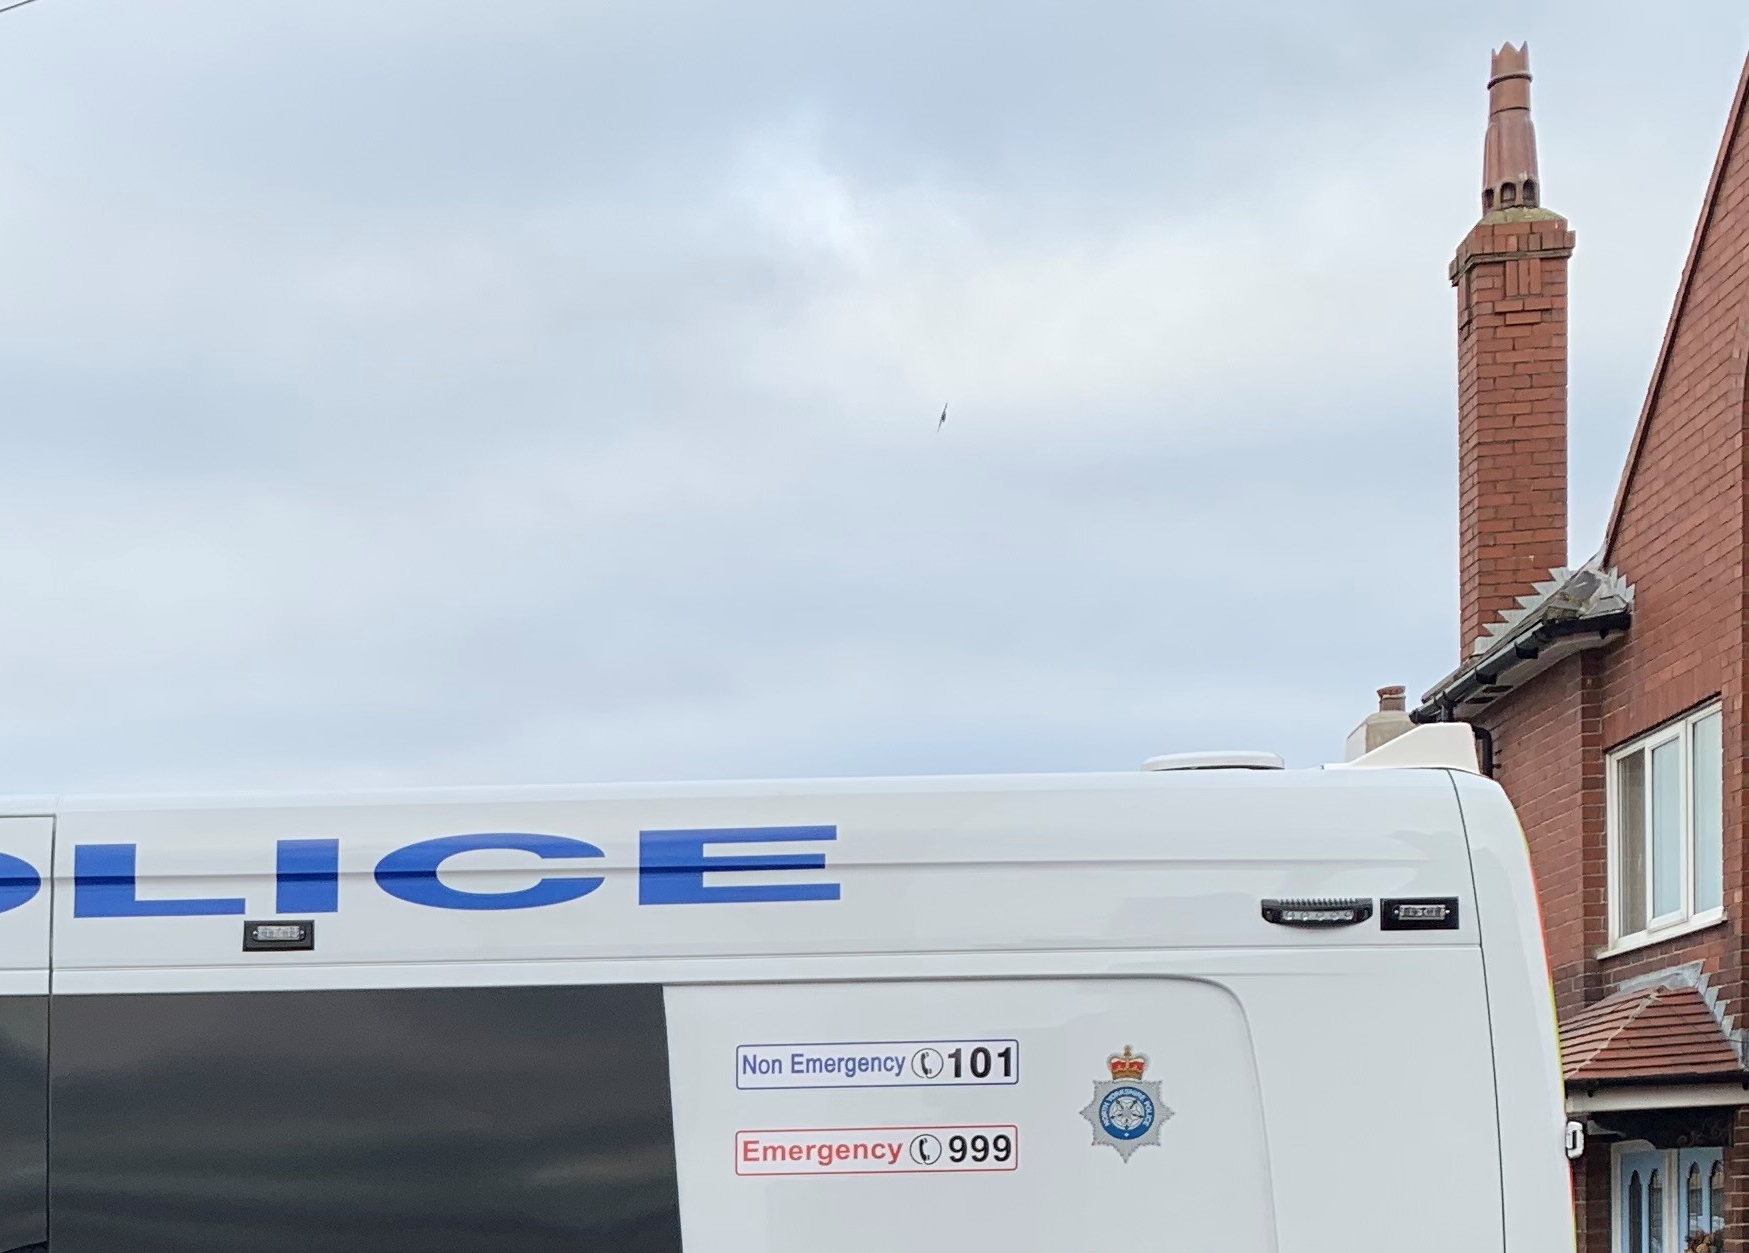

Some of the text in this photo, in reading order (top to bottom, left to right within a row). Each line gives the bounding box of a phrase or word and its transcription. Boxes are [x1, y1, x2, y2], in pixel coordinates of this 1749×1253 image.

[742, 1047, 1012, 1078] Non Emergency 101
[742, 1135, 1012, 1166] Emergency 999
